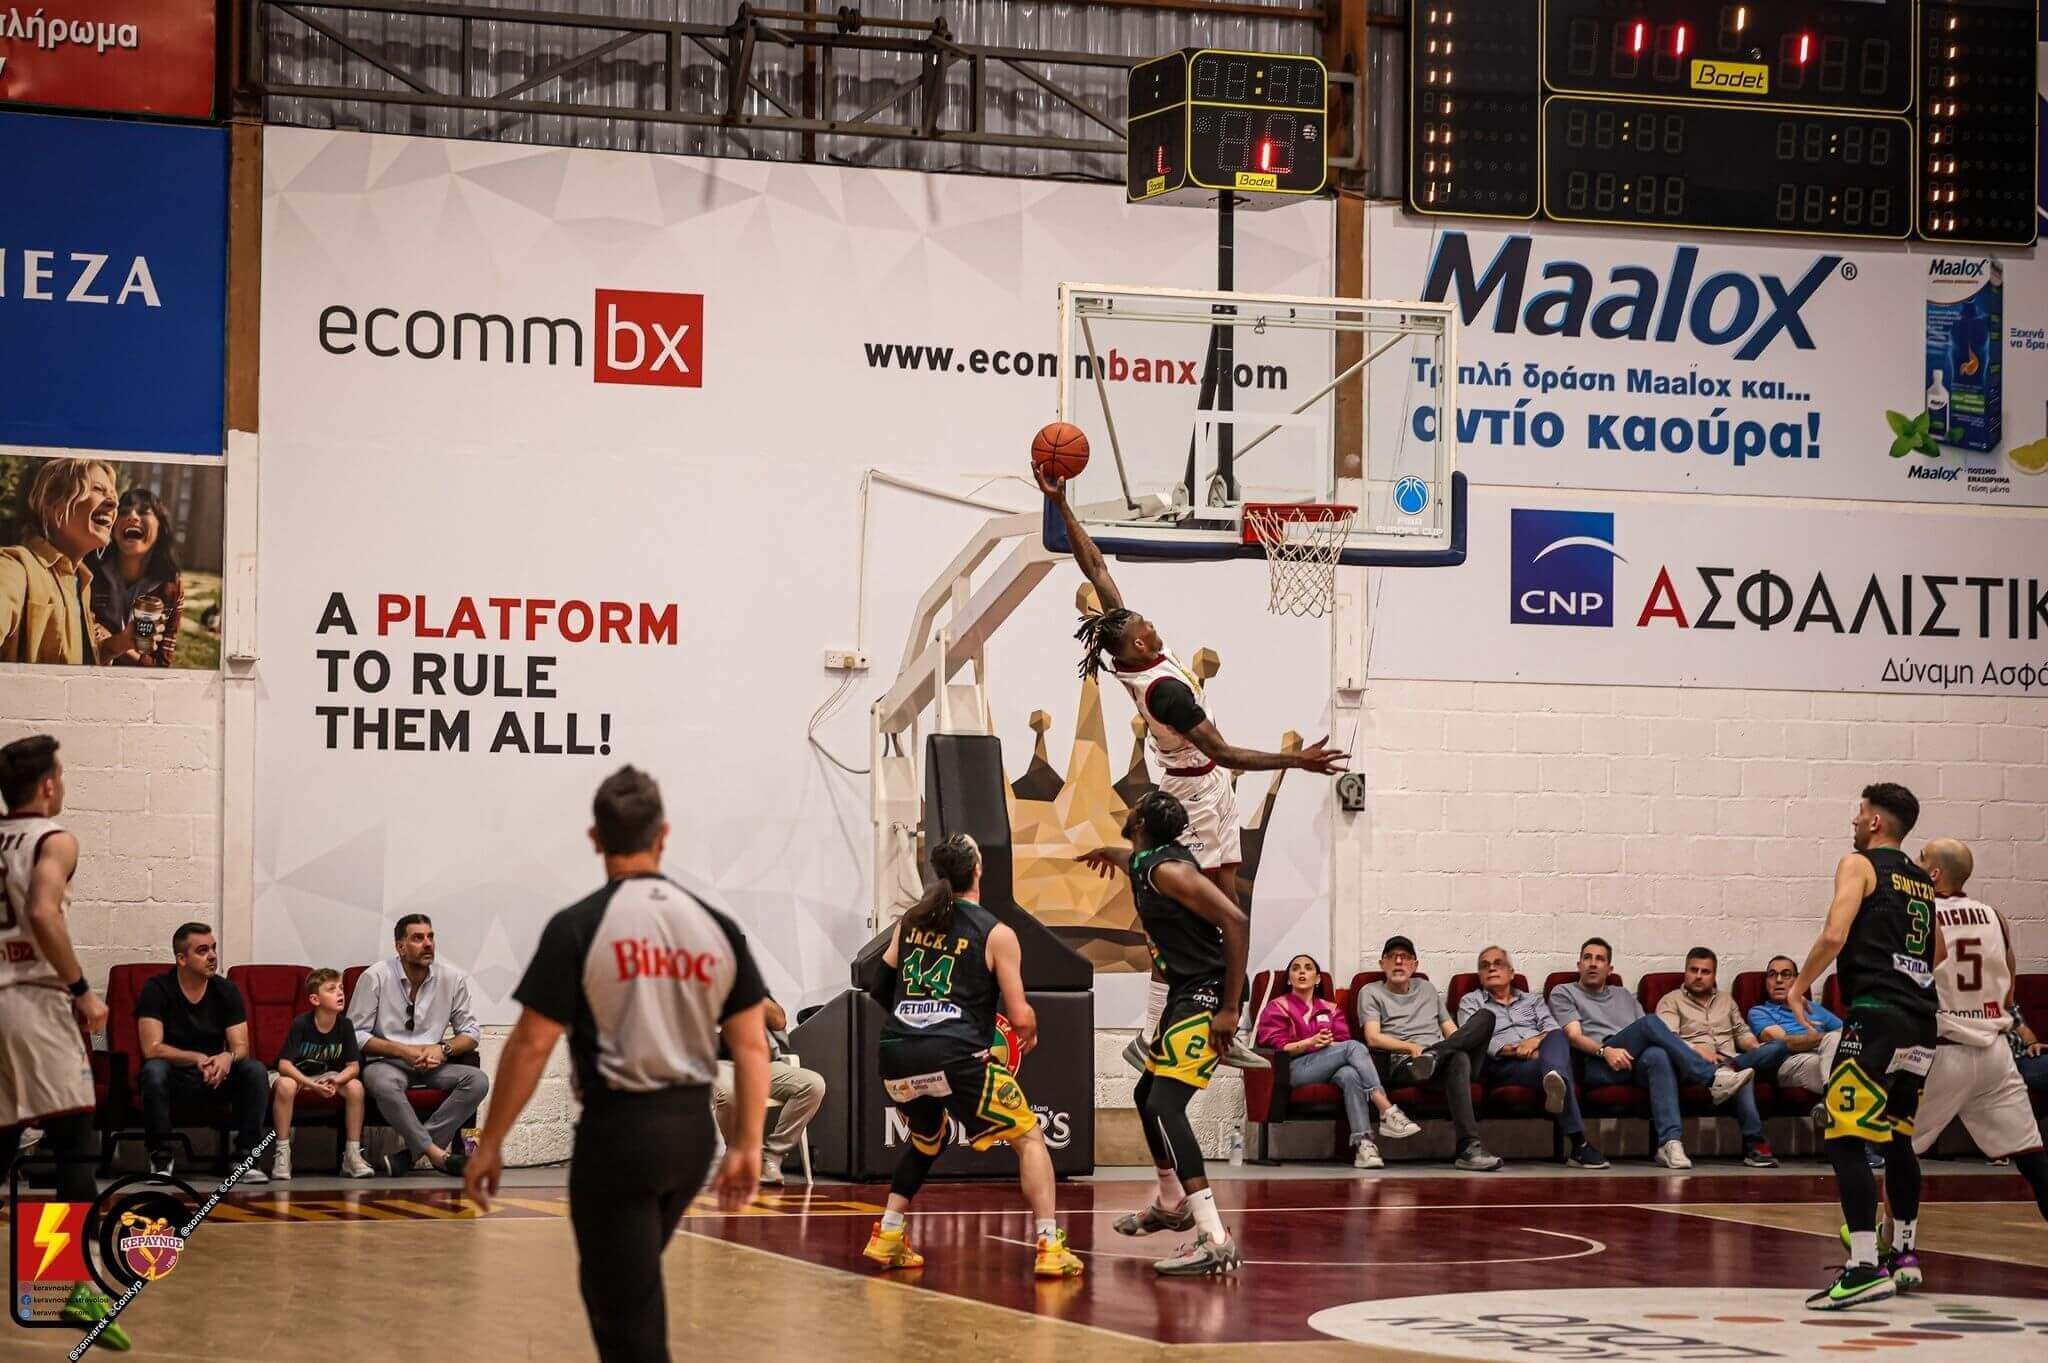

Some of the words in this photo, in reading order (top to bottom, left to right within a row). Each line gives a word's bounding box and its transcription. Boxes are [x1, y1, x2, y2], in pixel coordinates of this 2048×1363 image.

[1696, 64, 1764, 89] Bodet
[1239, 174, 1275, 188] Bodet
[1929, 259, 1988, 277] Maalox
[1523, 364, 1615, 394] δράση
[1627, 365, 1731, 397] Maalox
[1741, 378, 1811, 401] και...
[1587, 408, 1820, 466] καούρα!
[1908, 465, 1961, 482] Maalox
[1520, 590, 1604, 616] CNP
[316, 592, 358, 635] A
[377, 593, 678, 645] PLATFORM
[316, 649, 391, 693] TO
[412, 652, 557, 698] RULE
[1881, 657, 1973, 690] Δύναμη
[315, 706, 470, 752] THEM
[489, 711, 611, 756] ALL!
[1906, 900, 1930, 955] 3
[954, 938, 969, 955] P
[903, 948, 955, 1001] 44
[1956, 938, 1983, 991] 5
[1185, 1035, 1206, 1060] 2
[1839, 1086, 1856, 1113] 3
[1902, 1229, 1912, 1239] 3
